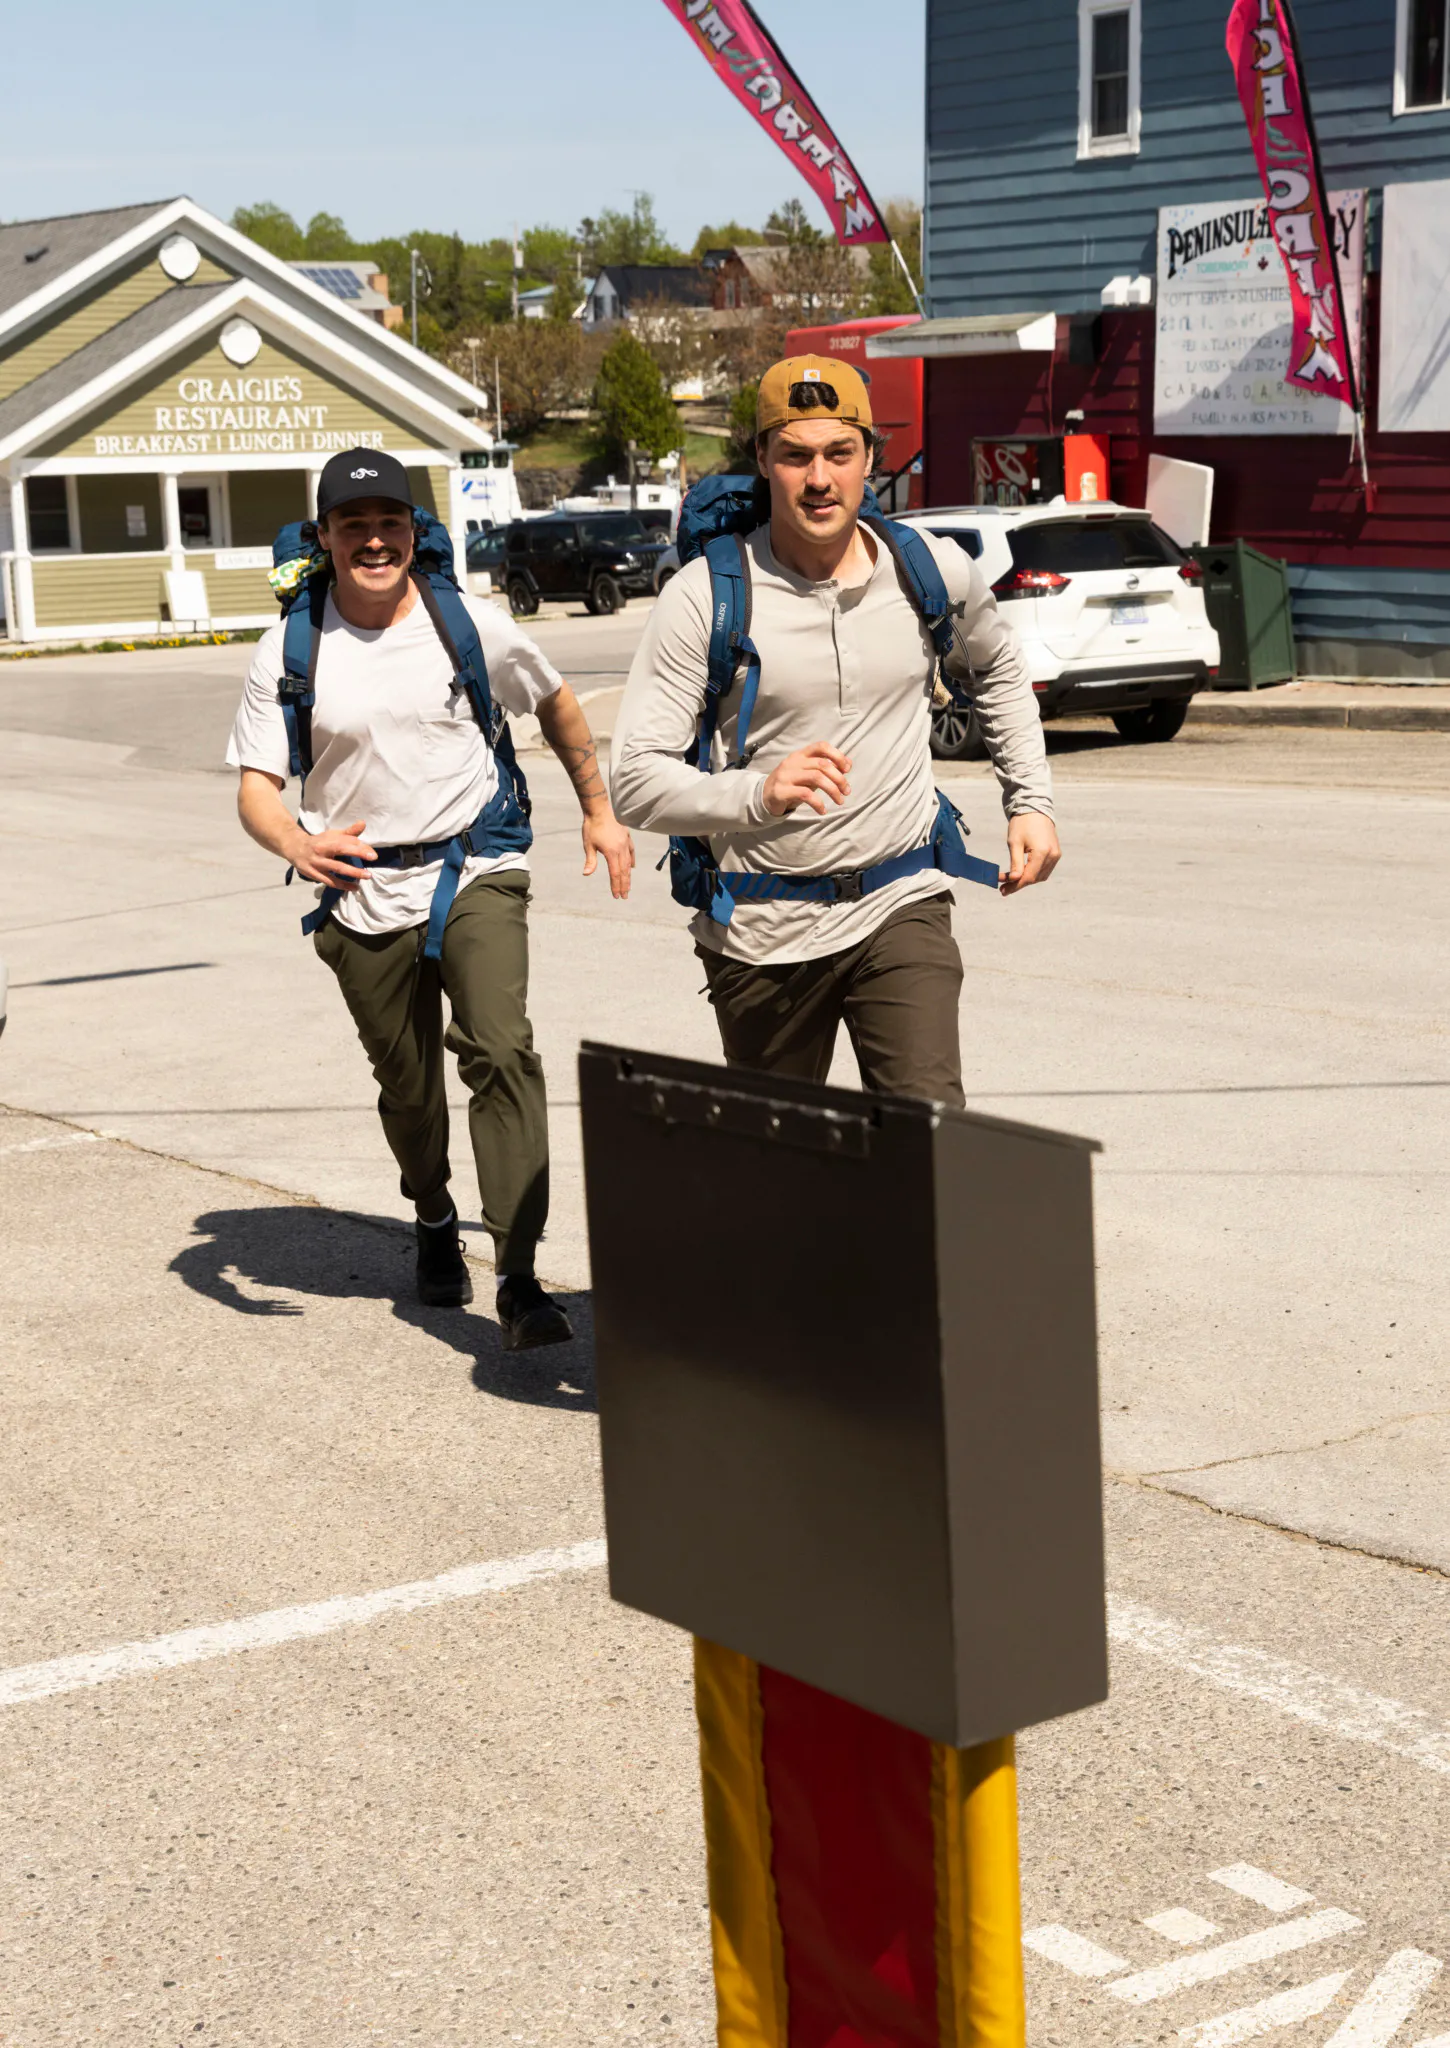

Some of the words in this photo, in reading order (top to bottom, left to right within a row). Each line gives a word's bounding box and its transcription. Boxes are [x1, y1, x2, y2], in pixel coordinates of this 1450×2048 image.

[178, 376, 303, 403] CRAIGIE'S
[155, 406, 328, 431] RESTAURANT
[94, 434, 212, 455] BREAKFAST
[229, 432, 295, 452] LUNCH
[312, 431, 384, 450] DINNER
[715, 602, 727, 632] OSPREY
